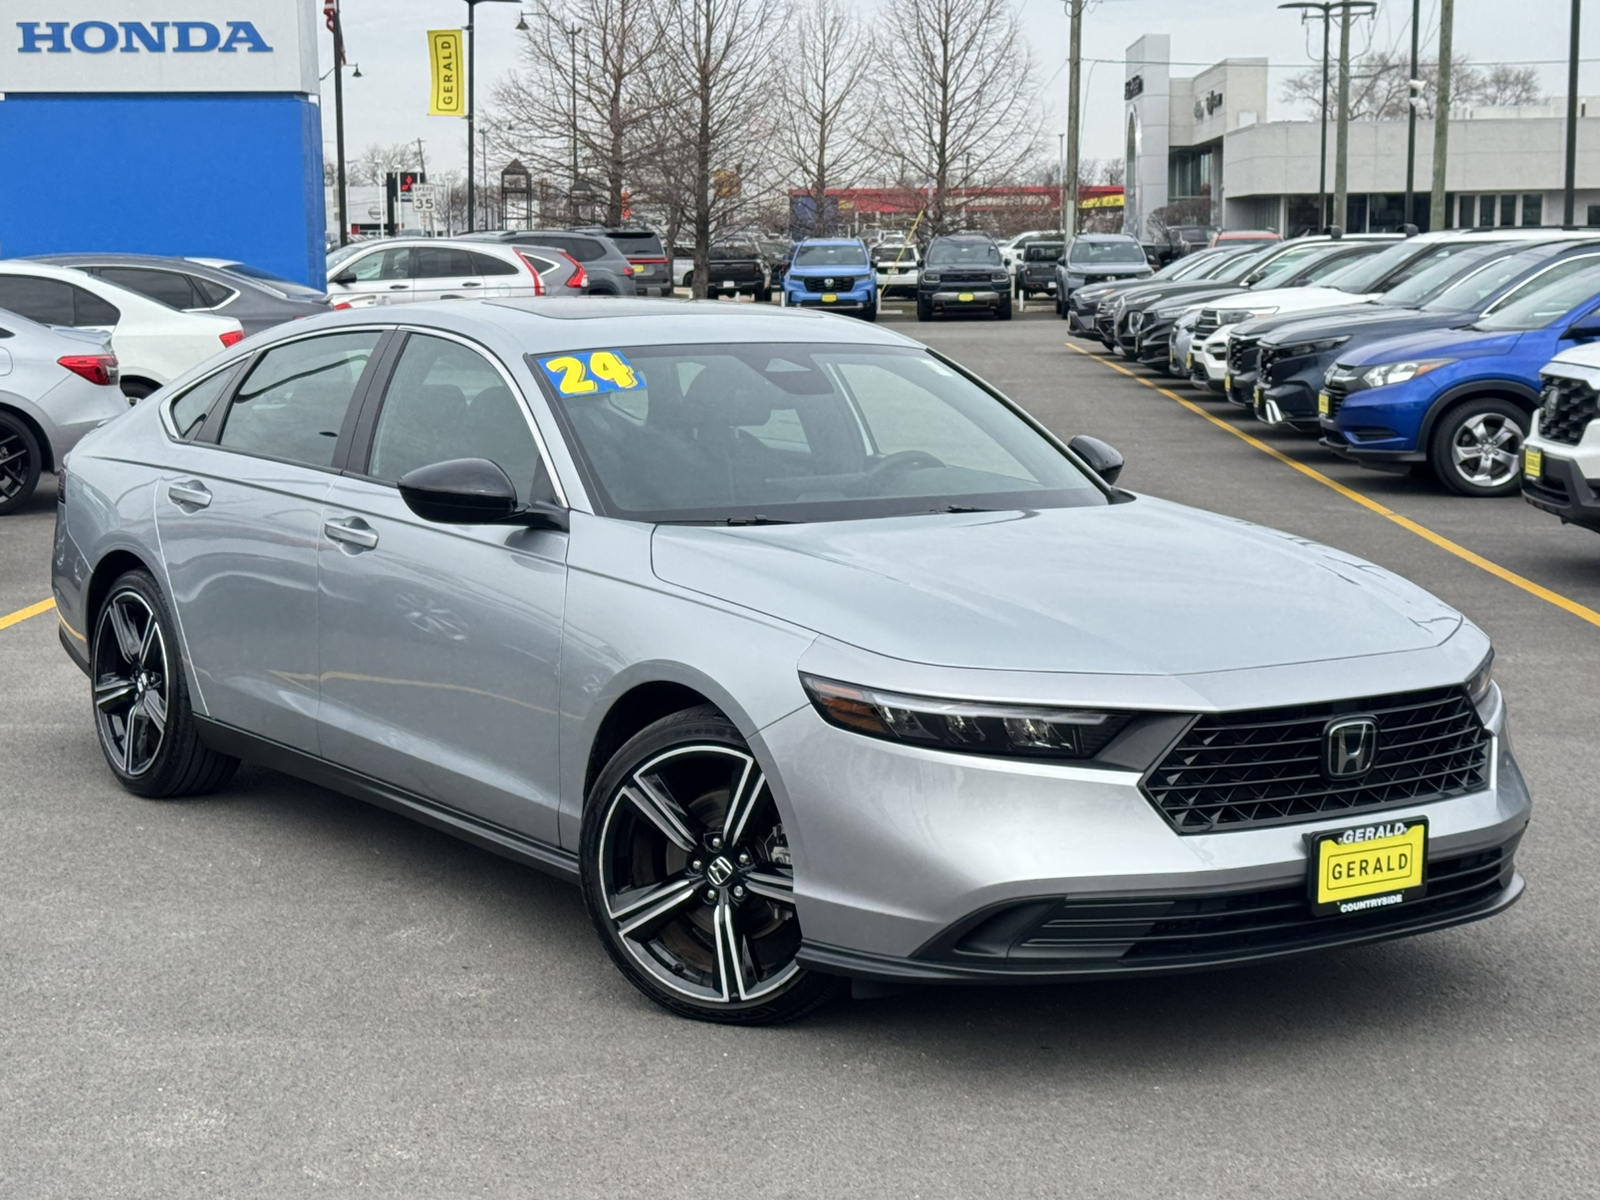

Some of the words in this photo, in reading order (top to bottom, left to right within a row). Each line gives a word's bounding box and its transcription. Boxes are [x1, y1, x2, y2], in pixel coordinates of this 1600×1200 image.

[16, 20, 273, 54] HONDA
[441, 41, 453, 105] GERALD
[415, 198, 434, 209] 35
[546, 352, 638, 394] 24
[1342, 822, 1405, 844] GERALD
[1332, 853, 1408, 880] GERALD
[1340, 894, 1403, 913] COUNTRYSIDE
